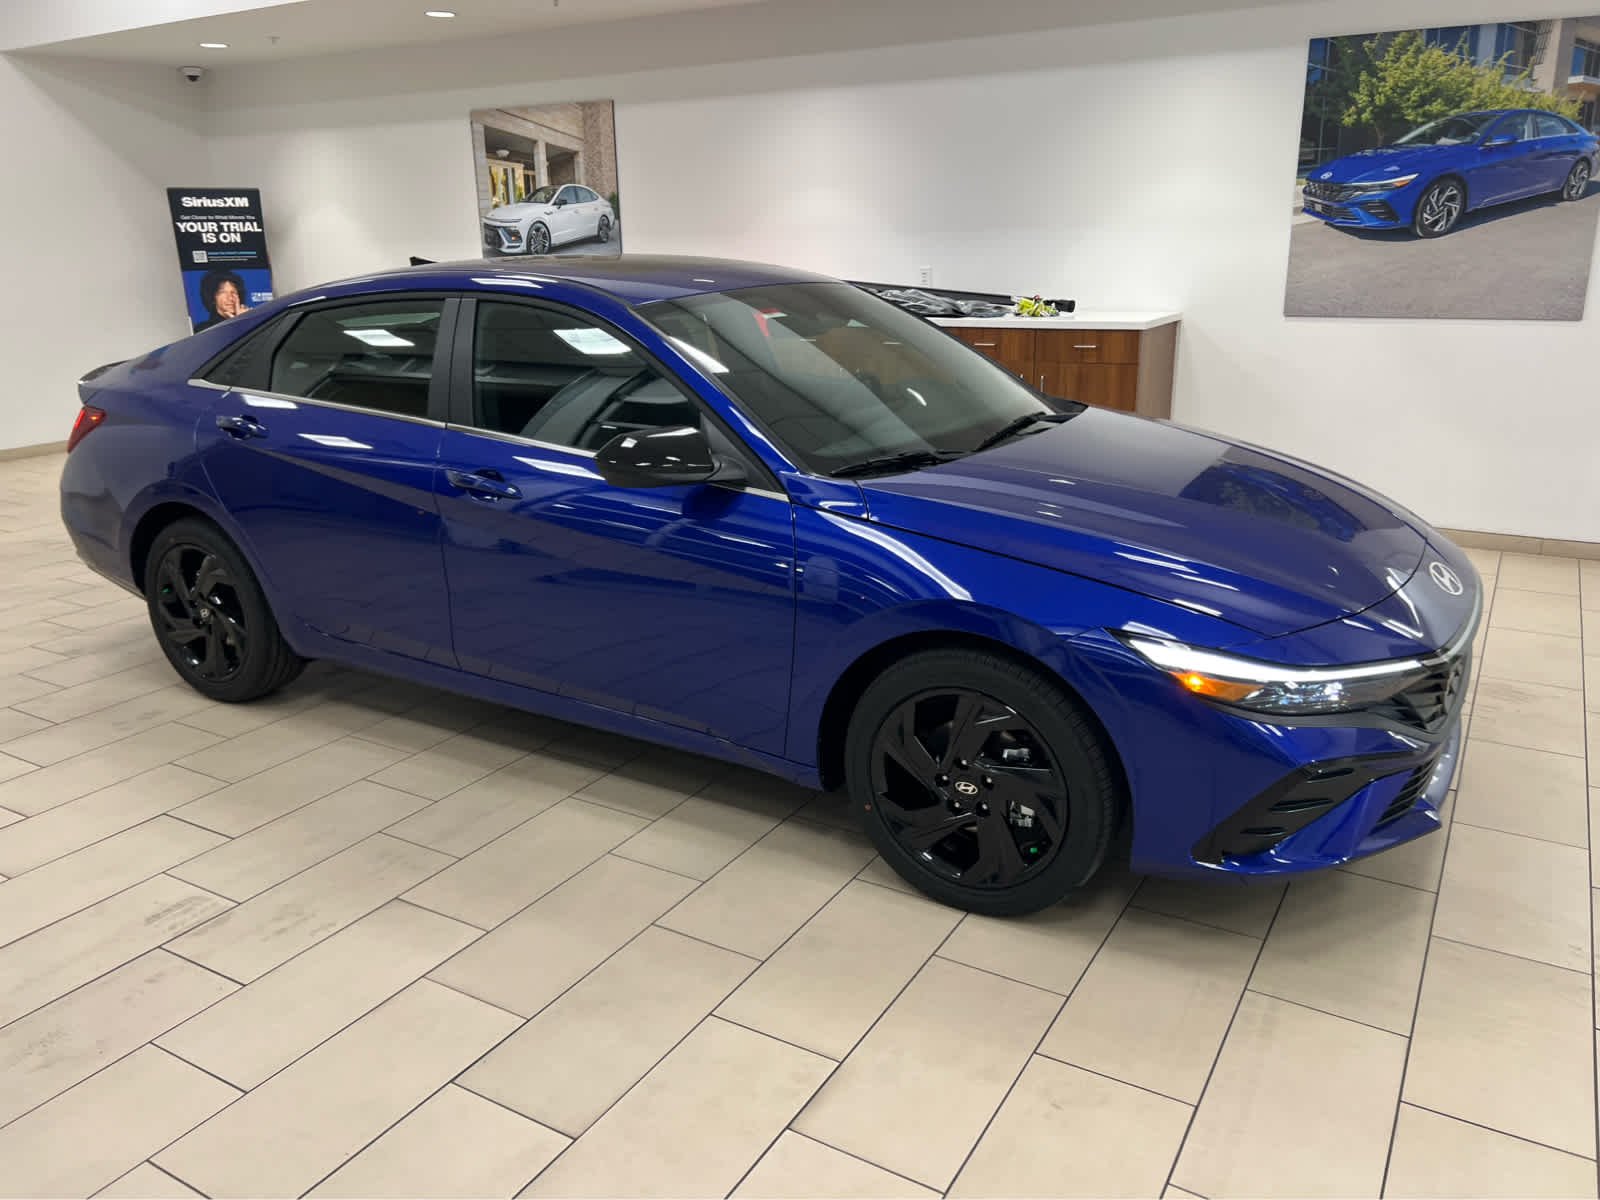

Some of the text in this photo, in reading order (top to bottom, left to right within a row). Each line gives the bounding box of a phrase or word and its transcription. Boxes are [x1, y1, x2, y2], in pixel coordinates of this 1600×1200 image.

[181, 196, 249, 208] SiriusXM
[176, 221, 262, 232] YOUR TRIAL
[202, 232, 242, 243] IS ON
